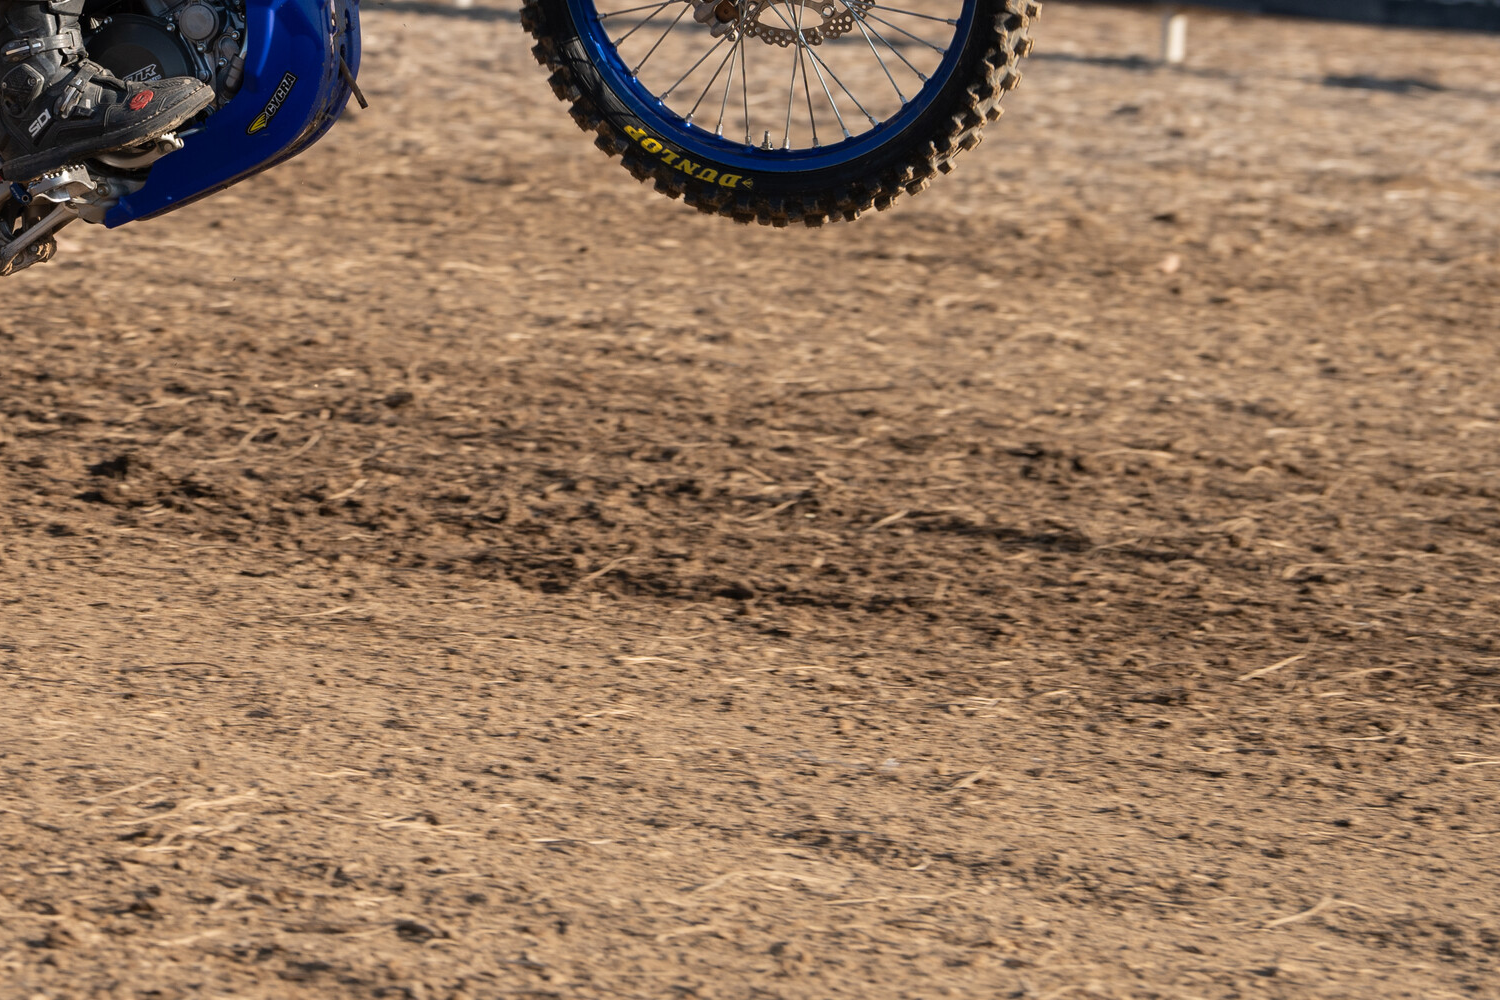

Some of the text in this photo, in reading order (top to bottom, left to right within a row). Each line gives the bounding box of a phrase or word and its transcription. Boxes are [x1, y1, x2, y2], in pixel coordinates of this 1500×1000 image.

[265, 72, 297, 117] CYCRA
[28, 108, 52, 139] SIDI
[623, 125, 745, 188] DUNLOP
